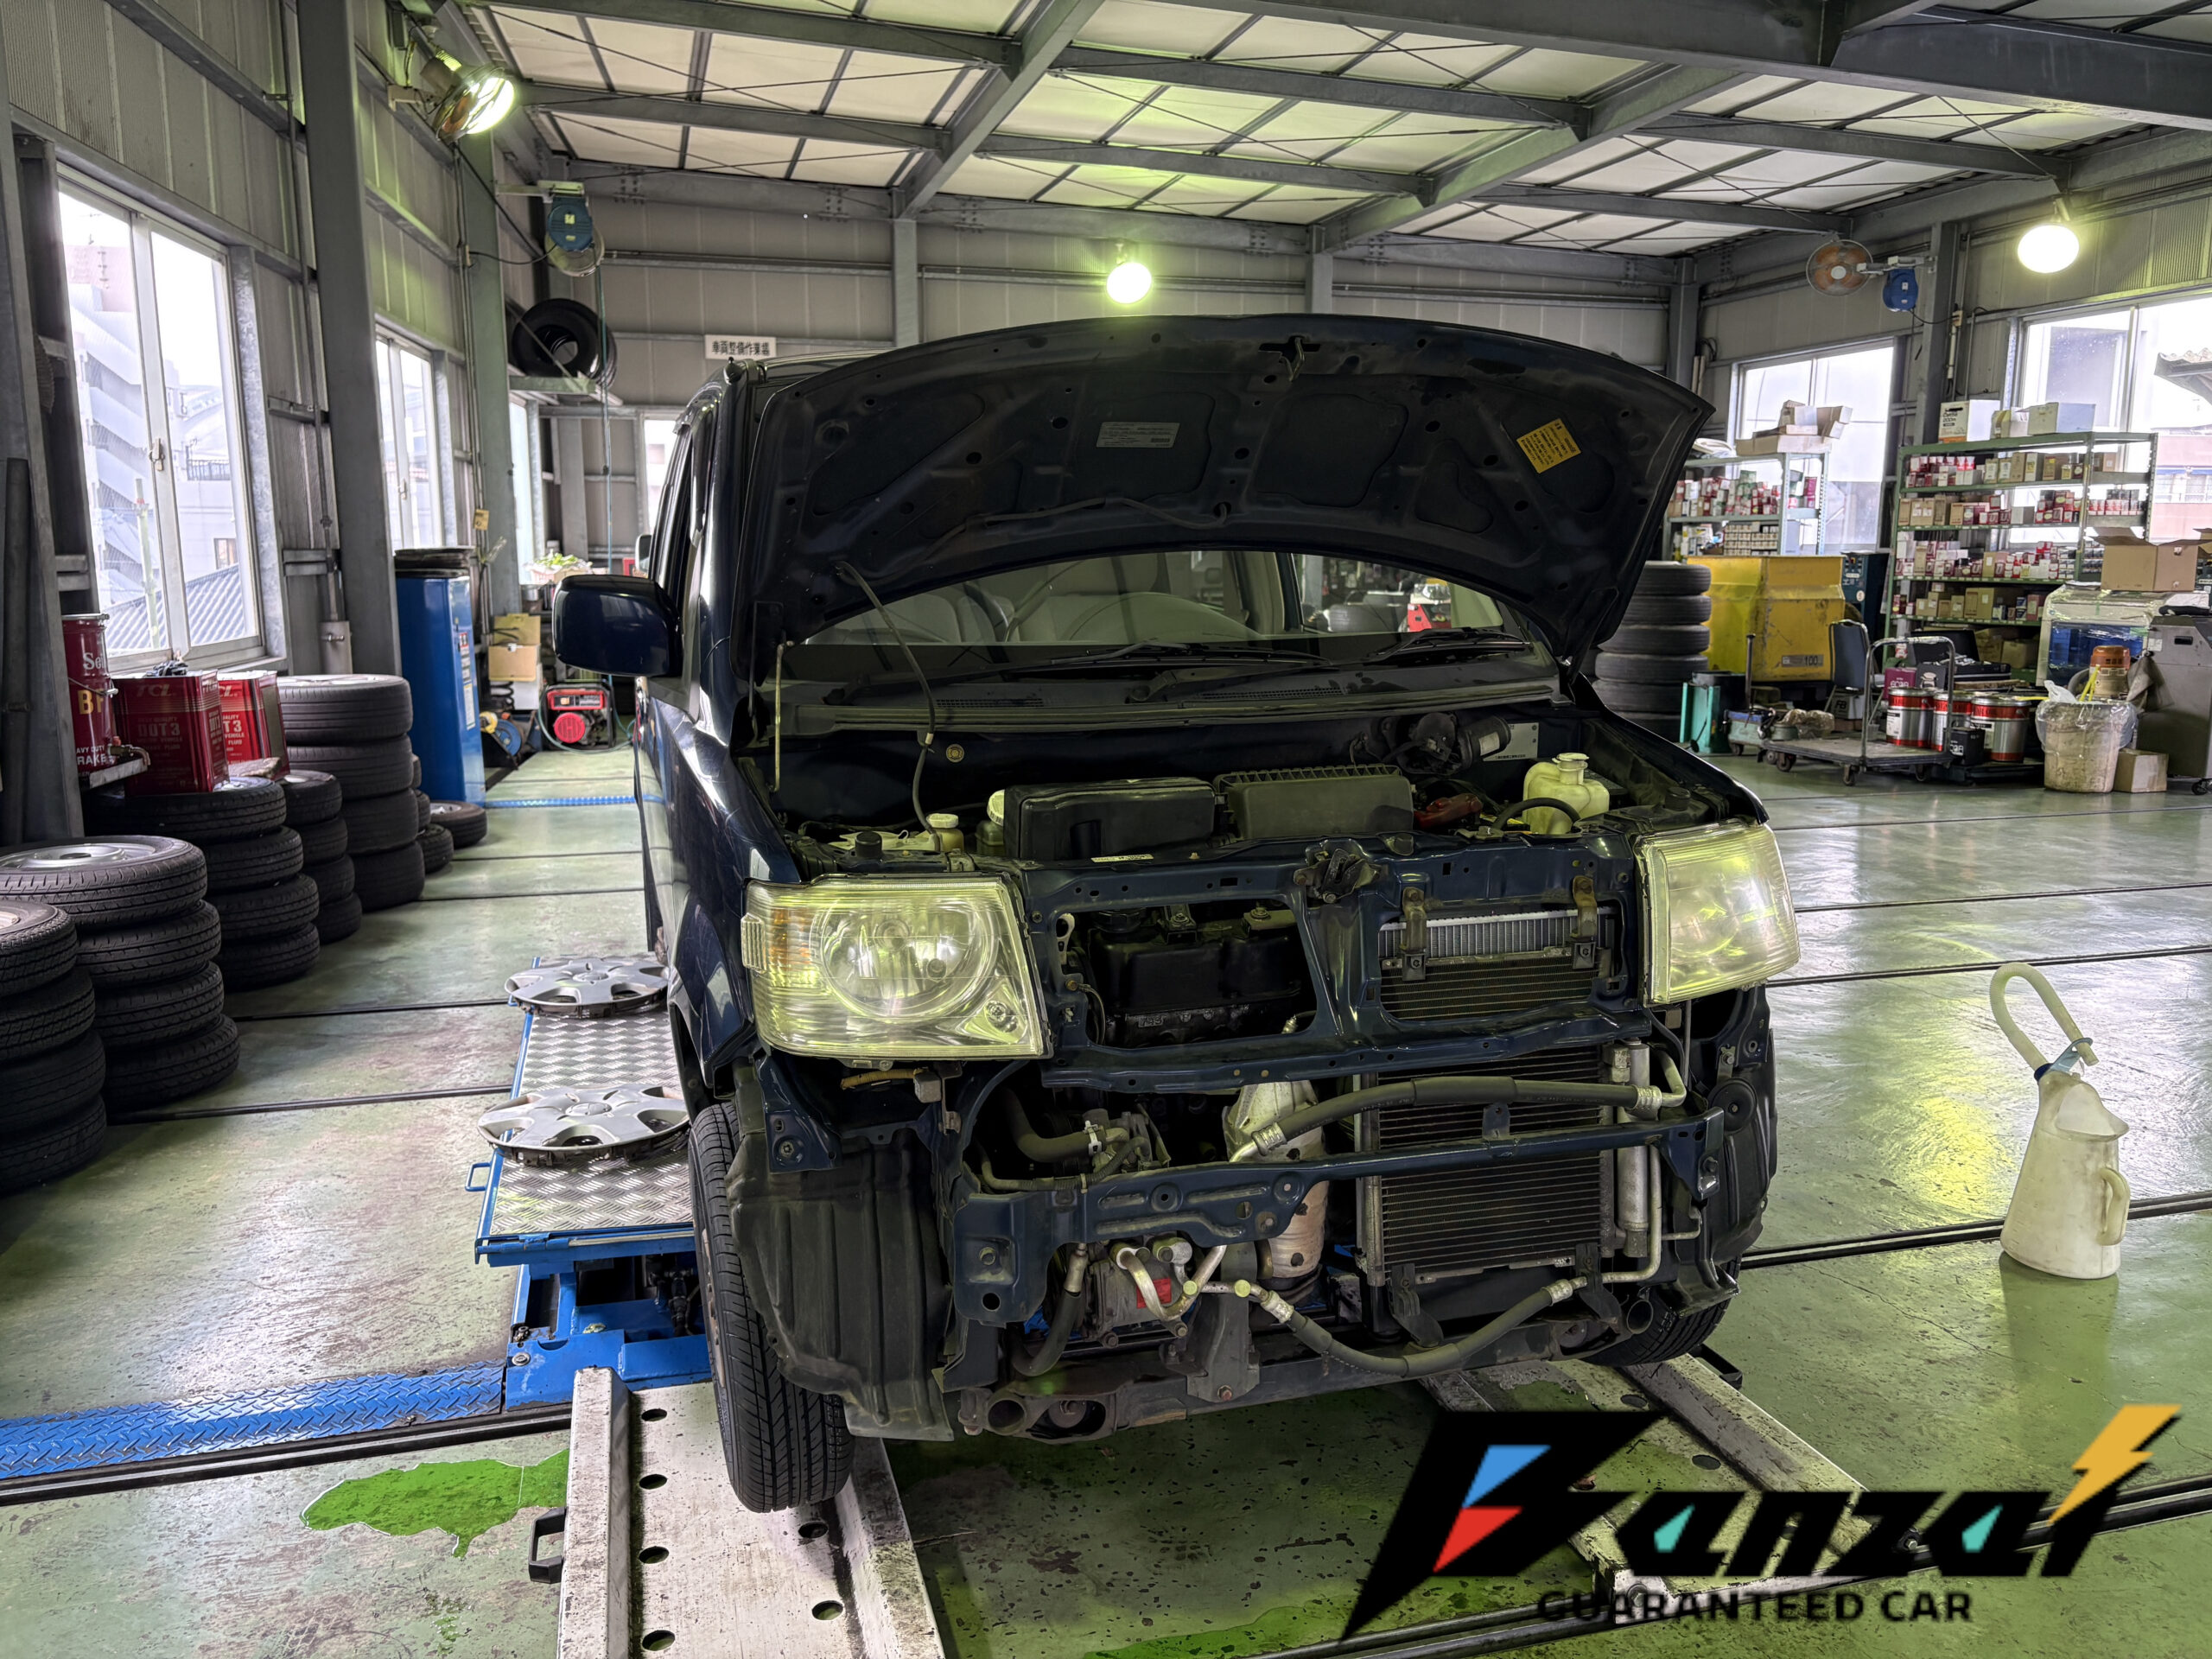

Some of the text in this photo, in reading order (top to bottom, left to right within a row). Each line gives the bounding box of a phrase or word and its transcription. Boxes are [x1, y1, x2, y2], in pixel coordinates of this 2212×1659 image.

[83, 652, 105, 670] Sei
[219, 685, 236, 696] CL
[77, 753, 106, 766] RAKE
